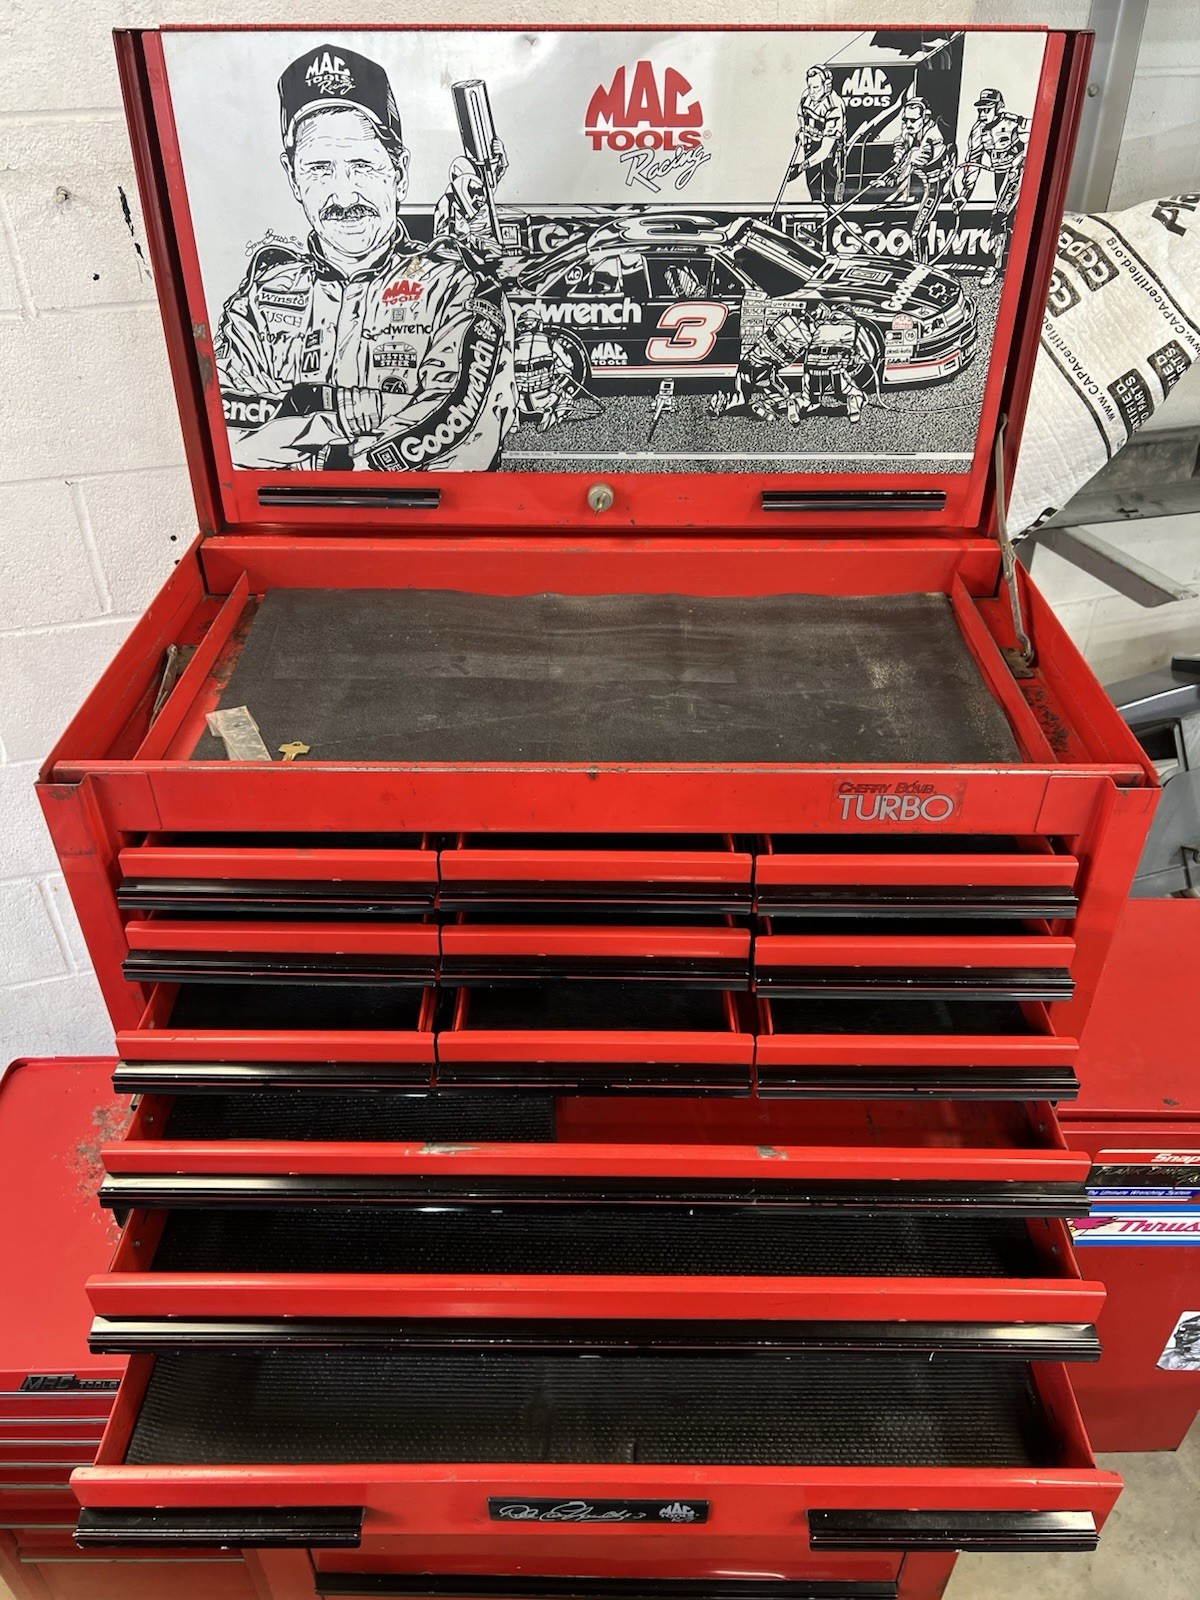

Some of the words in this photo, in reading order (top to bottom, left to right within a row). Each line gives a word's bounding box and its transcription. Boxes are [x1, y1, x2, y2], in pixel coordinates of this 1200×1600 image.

[305, 51, 351, 80] MAC
[841, 67, 893, 95] MAC
[585, 60, 704, 128] MAC
[584, 130, 703, 151] TOOLS
[619, 144, 712, 193] Racing
[381, 279, 426, 301] MAC
[1106, 237, 1200, 355] ww.CAPAcertified.org
[266, 311, 303, 328] USCH
[645, 300, 729, 362] 3
[374, 353, 417, 361] WESTERN
[590, 342, 629, 360] MAC
[838, 781, 892, 794] CHERRY
[838, 794, 954, 822] TURBO
[659, 1502, 695, 1517] MAC
